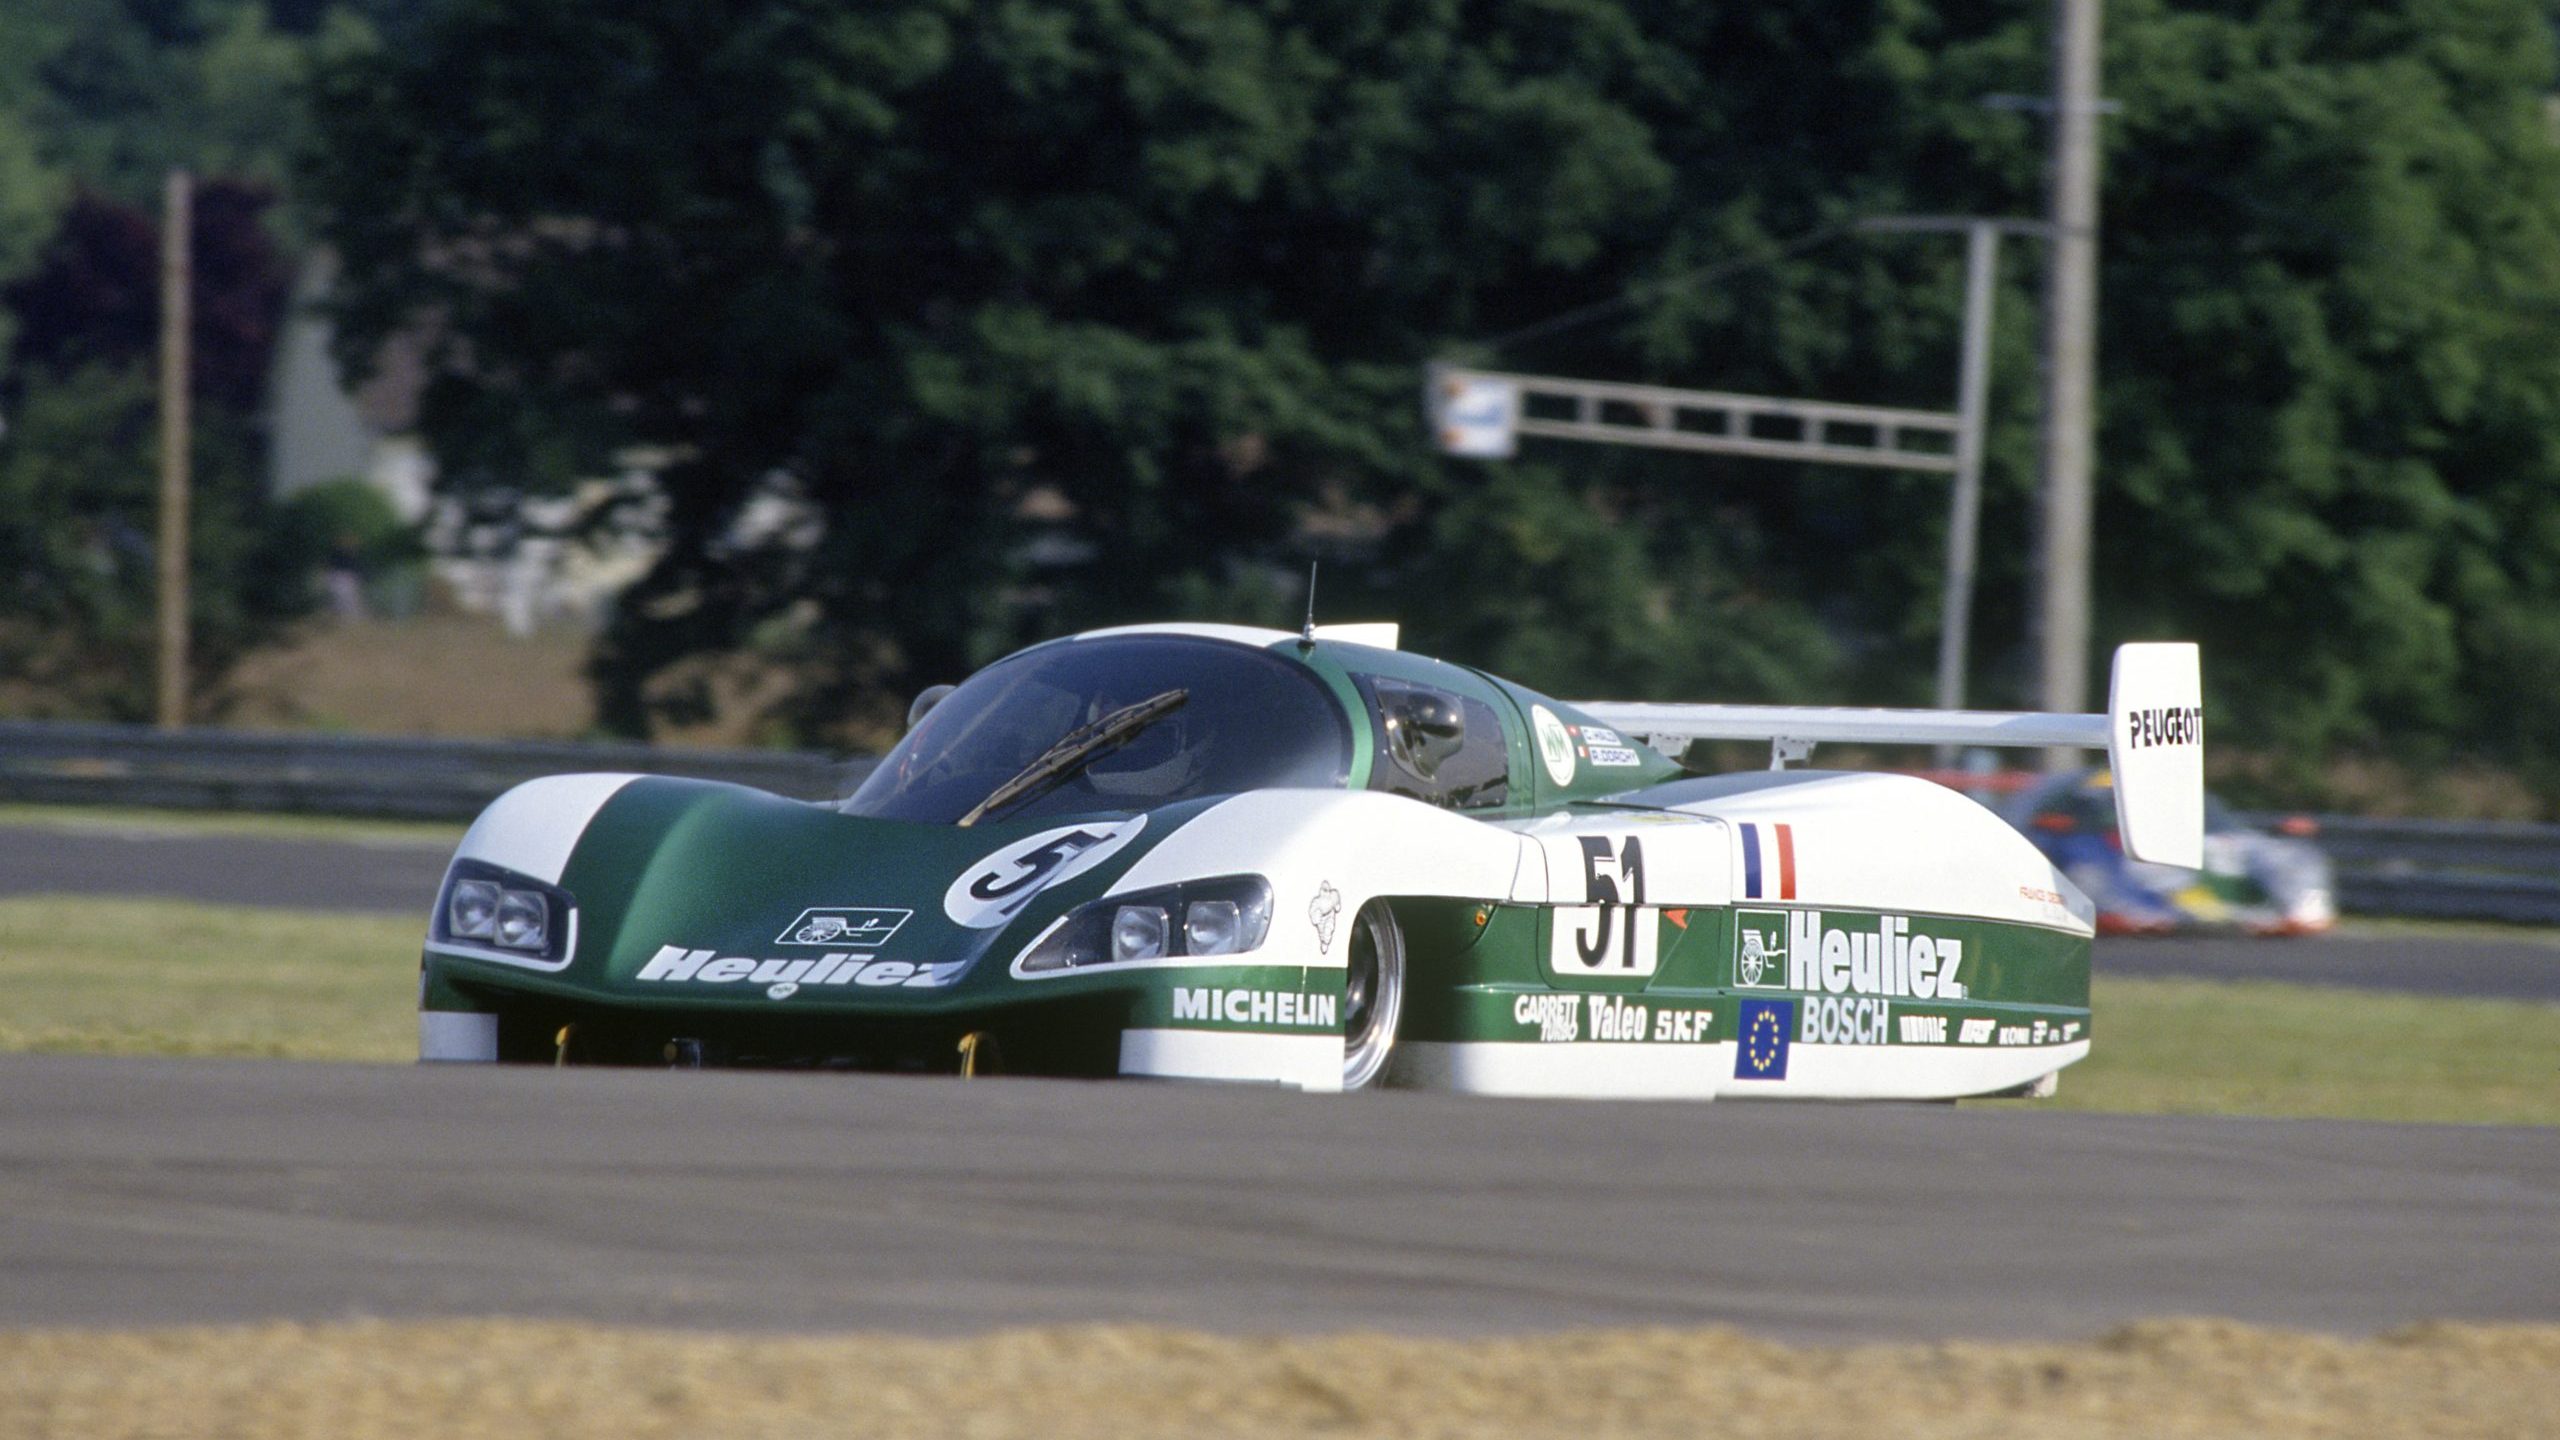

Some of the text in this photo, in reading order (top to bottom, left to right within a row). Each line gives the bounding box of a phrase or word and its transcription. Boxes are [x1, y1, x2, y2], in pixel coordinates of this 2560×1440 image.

[2129, 706, 2202, 750] PEUGEOT
[1575, 835, 1646, 969] 51
[635, 944, 967, 988] Heuliez
[1789, 910, 1963, 999] Heuliez
[1173, 987, 1336, 1027] MICHELIN
[1514, 994, 1580, 1025] GARRETT
[1588, 995, 1648, 1041] Valeo
[1654, 1009, 1714, 1041] SKF
[1801, 996, 1889, 1045] BOSCH
